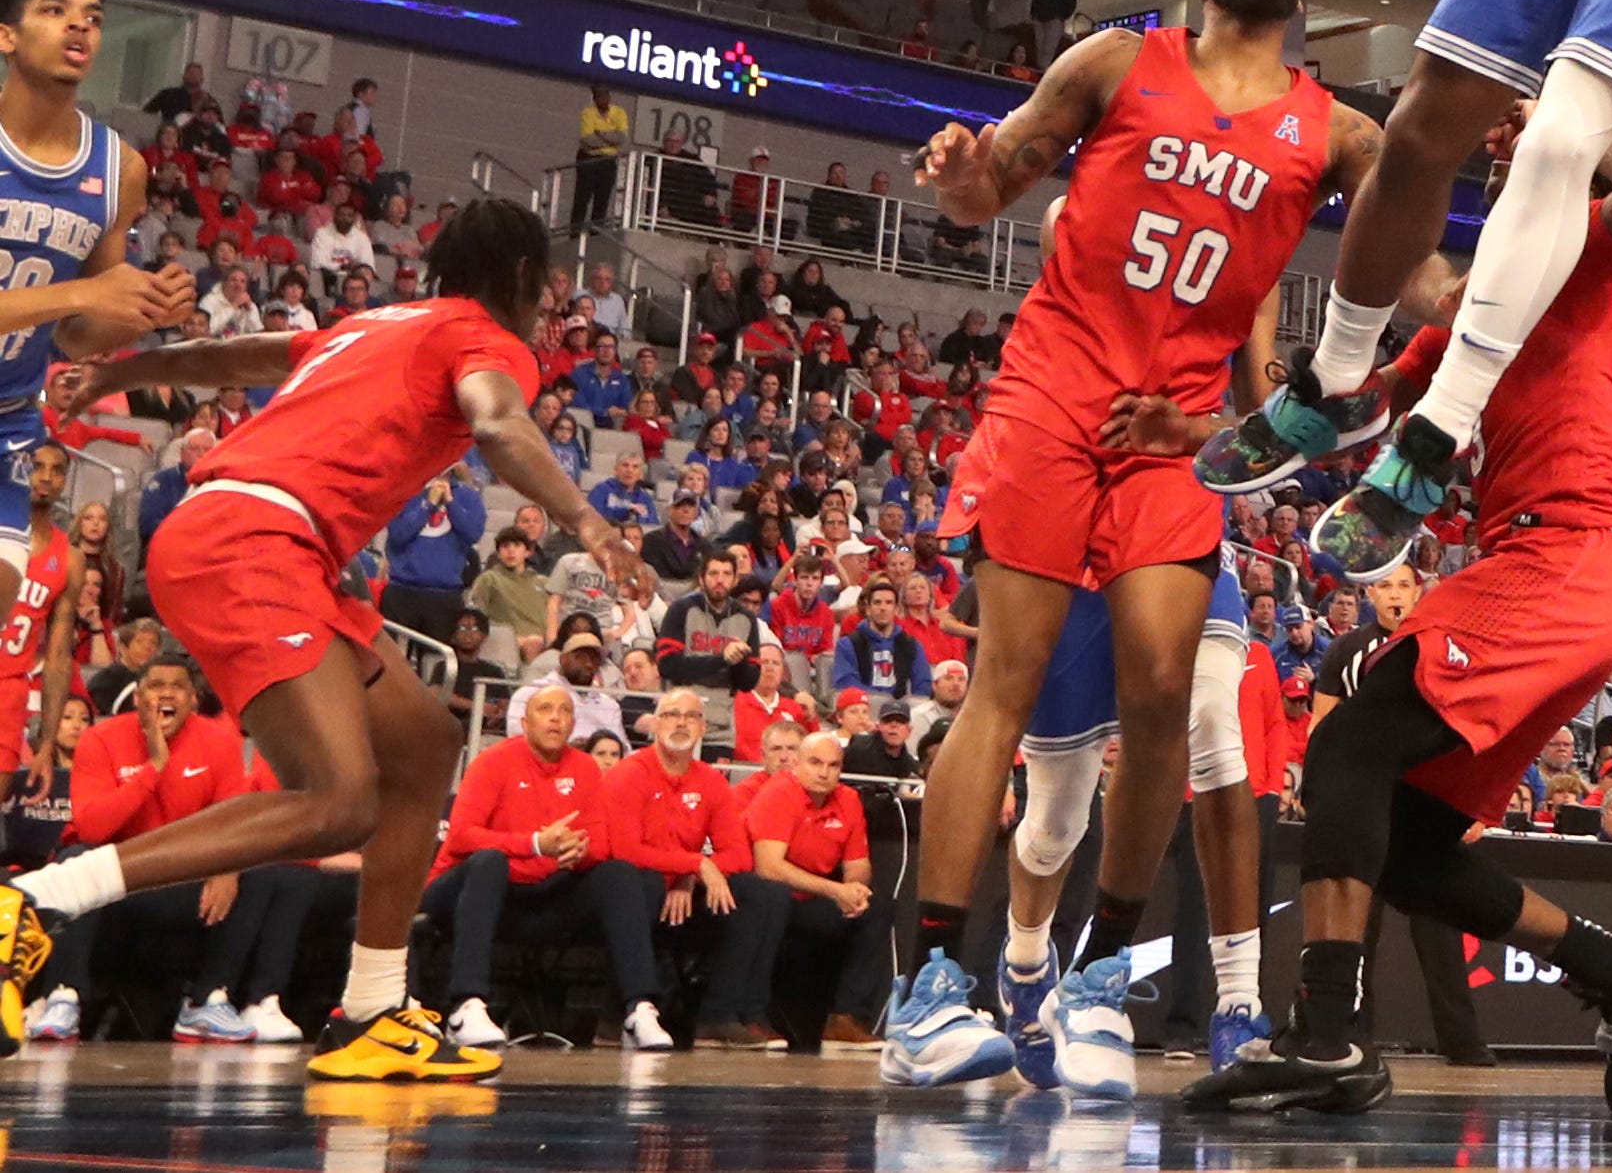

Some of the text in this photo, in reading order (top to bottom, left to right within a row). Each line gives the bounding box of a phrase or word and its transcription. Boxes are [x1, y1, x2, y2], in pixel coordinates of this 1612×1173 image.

[245, 30, 320, 72] 107
[582, 28, 721, 89] reliant
[651, 108, 712, 148] 108
[1144, 135, 1270, 212] SMU
[1124, 209, 1231, 305] 50
[3, 615, 32, 656] 3
